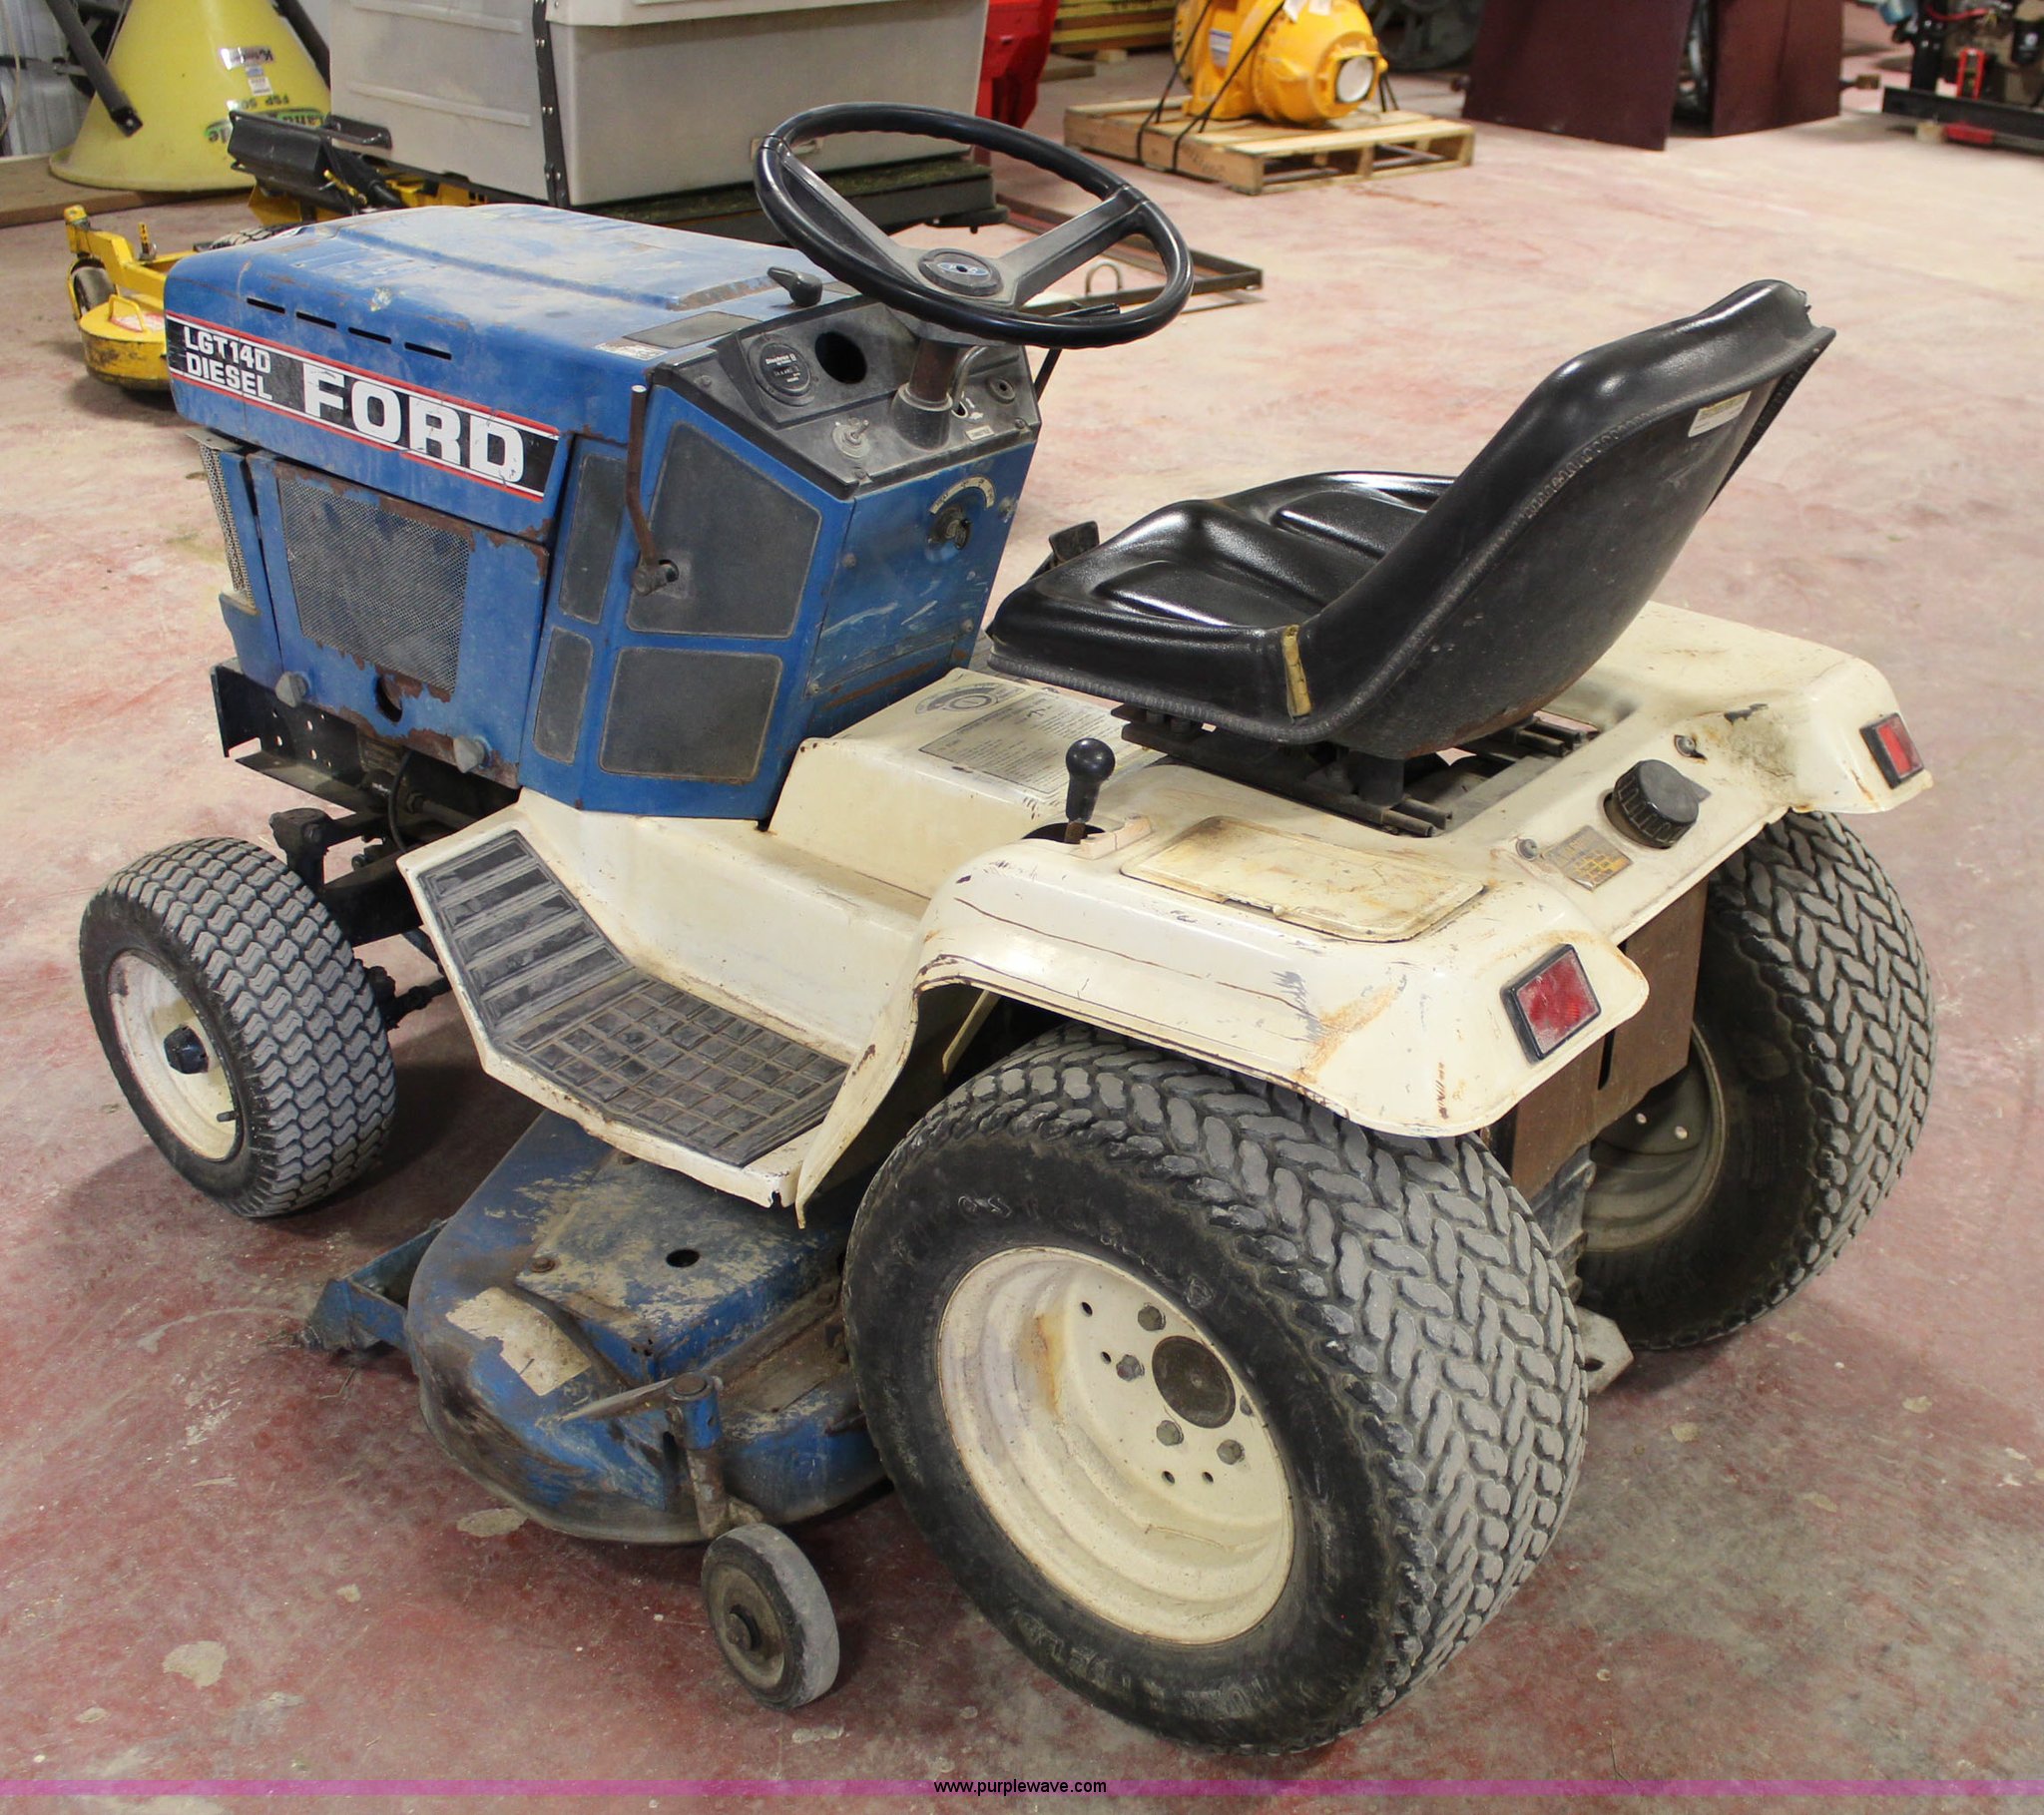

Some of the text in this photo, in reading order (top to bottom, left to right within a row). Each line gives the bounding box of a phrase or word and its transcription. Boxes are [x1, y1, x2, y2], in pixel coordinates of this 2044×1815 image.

[184, 325, 271, 374] LGT14D
[185, 350, 273, 401] DIESEL
[302, 363, 524, 483] FORD
